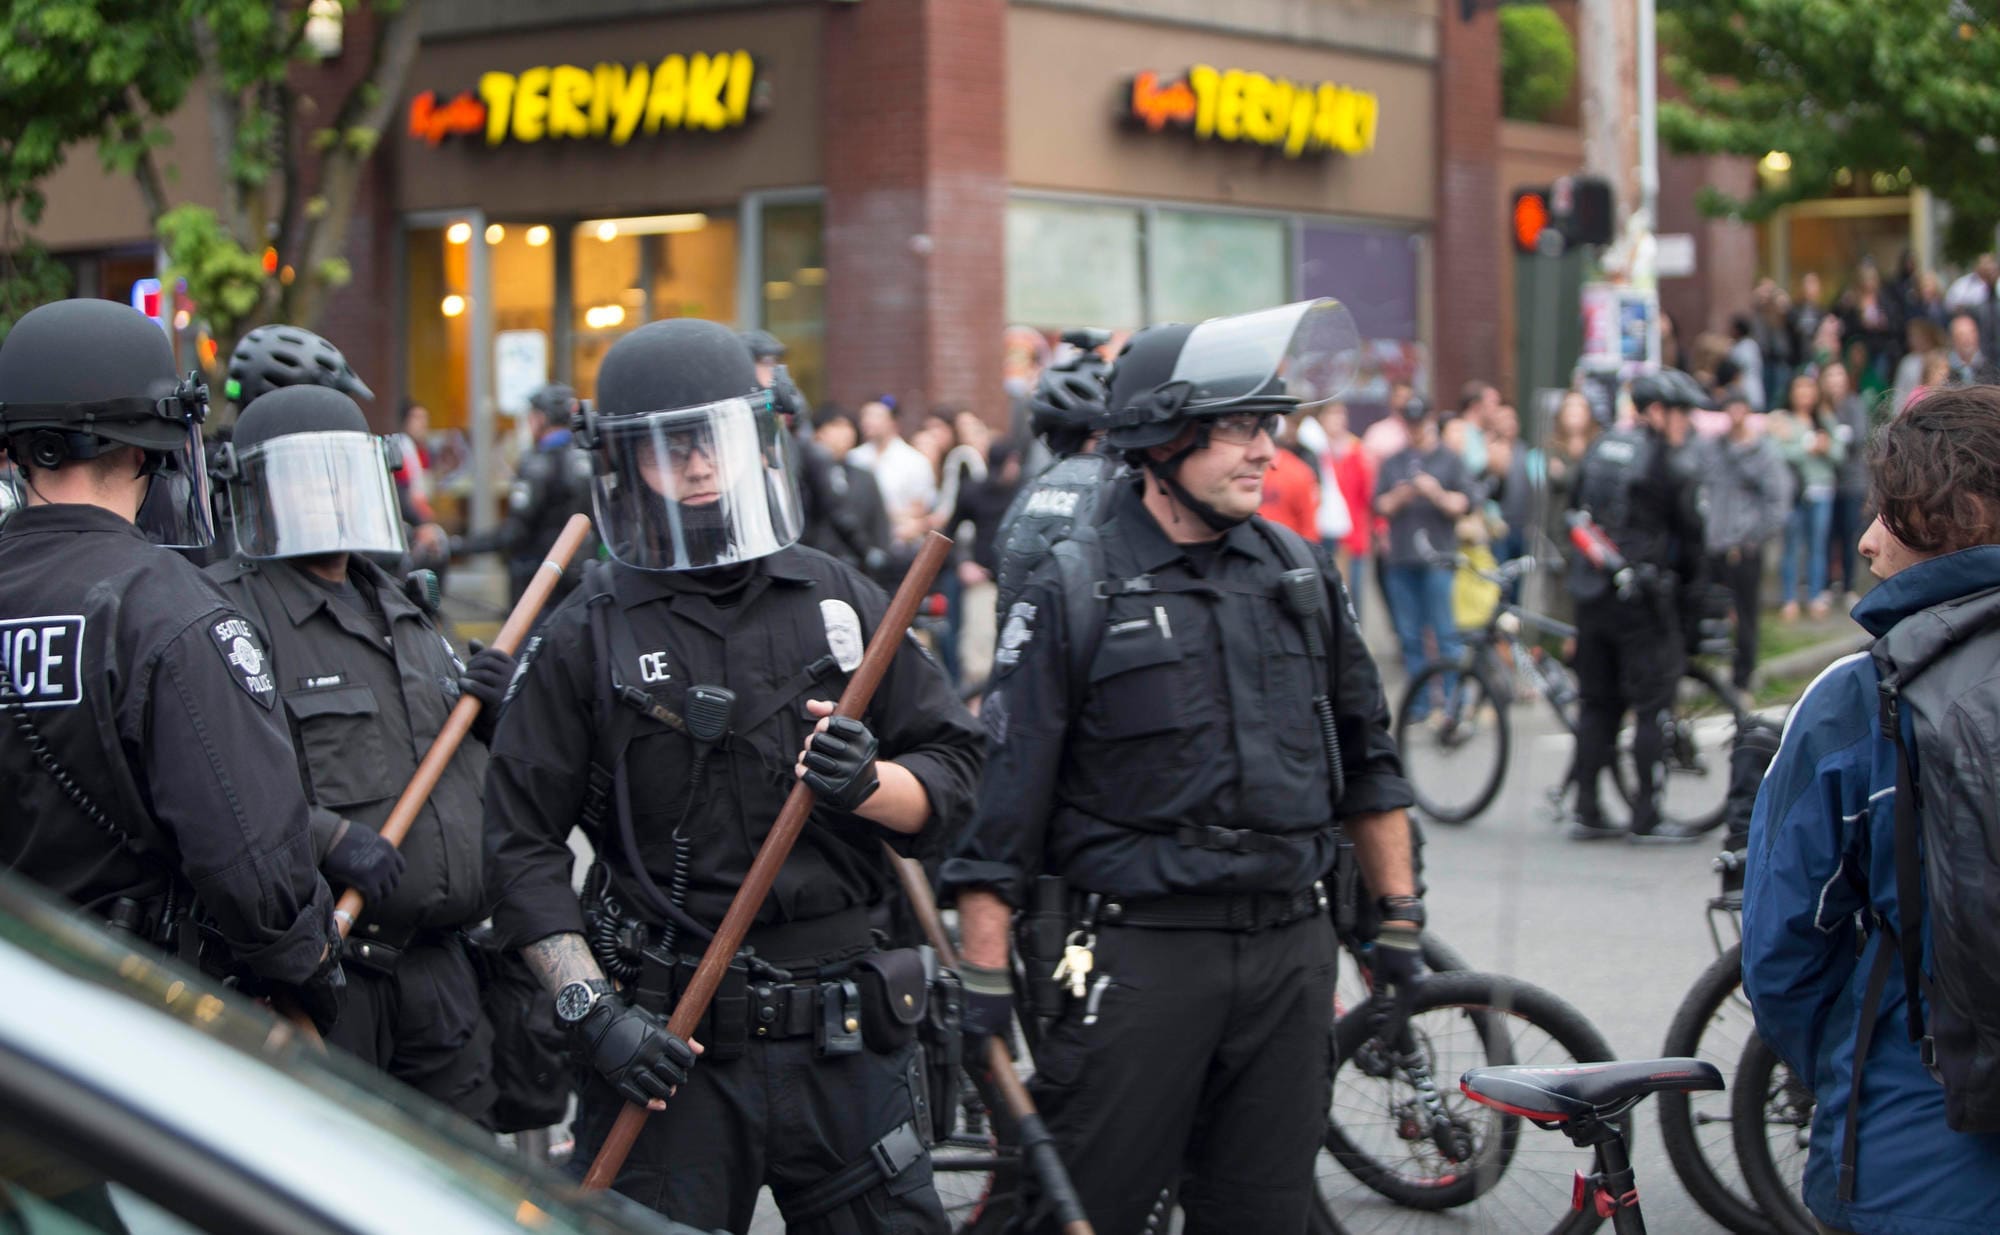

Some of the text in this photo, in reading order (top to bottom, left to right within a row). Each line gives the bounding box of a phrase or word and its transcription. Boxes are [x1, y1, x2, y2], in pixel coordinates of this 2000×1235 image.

[479, 49, 754, 146] TERIYAKI
[215, 619, 252, 642] SEATTLE
[245, 673, 273, 693] POLICE
